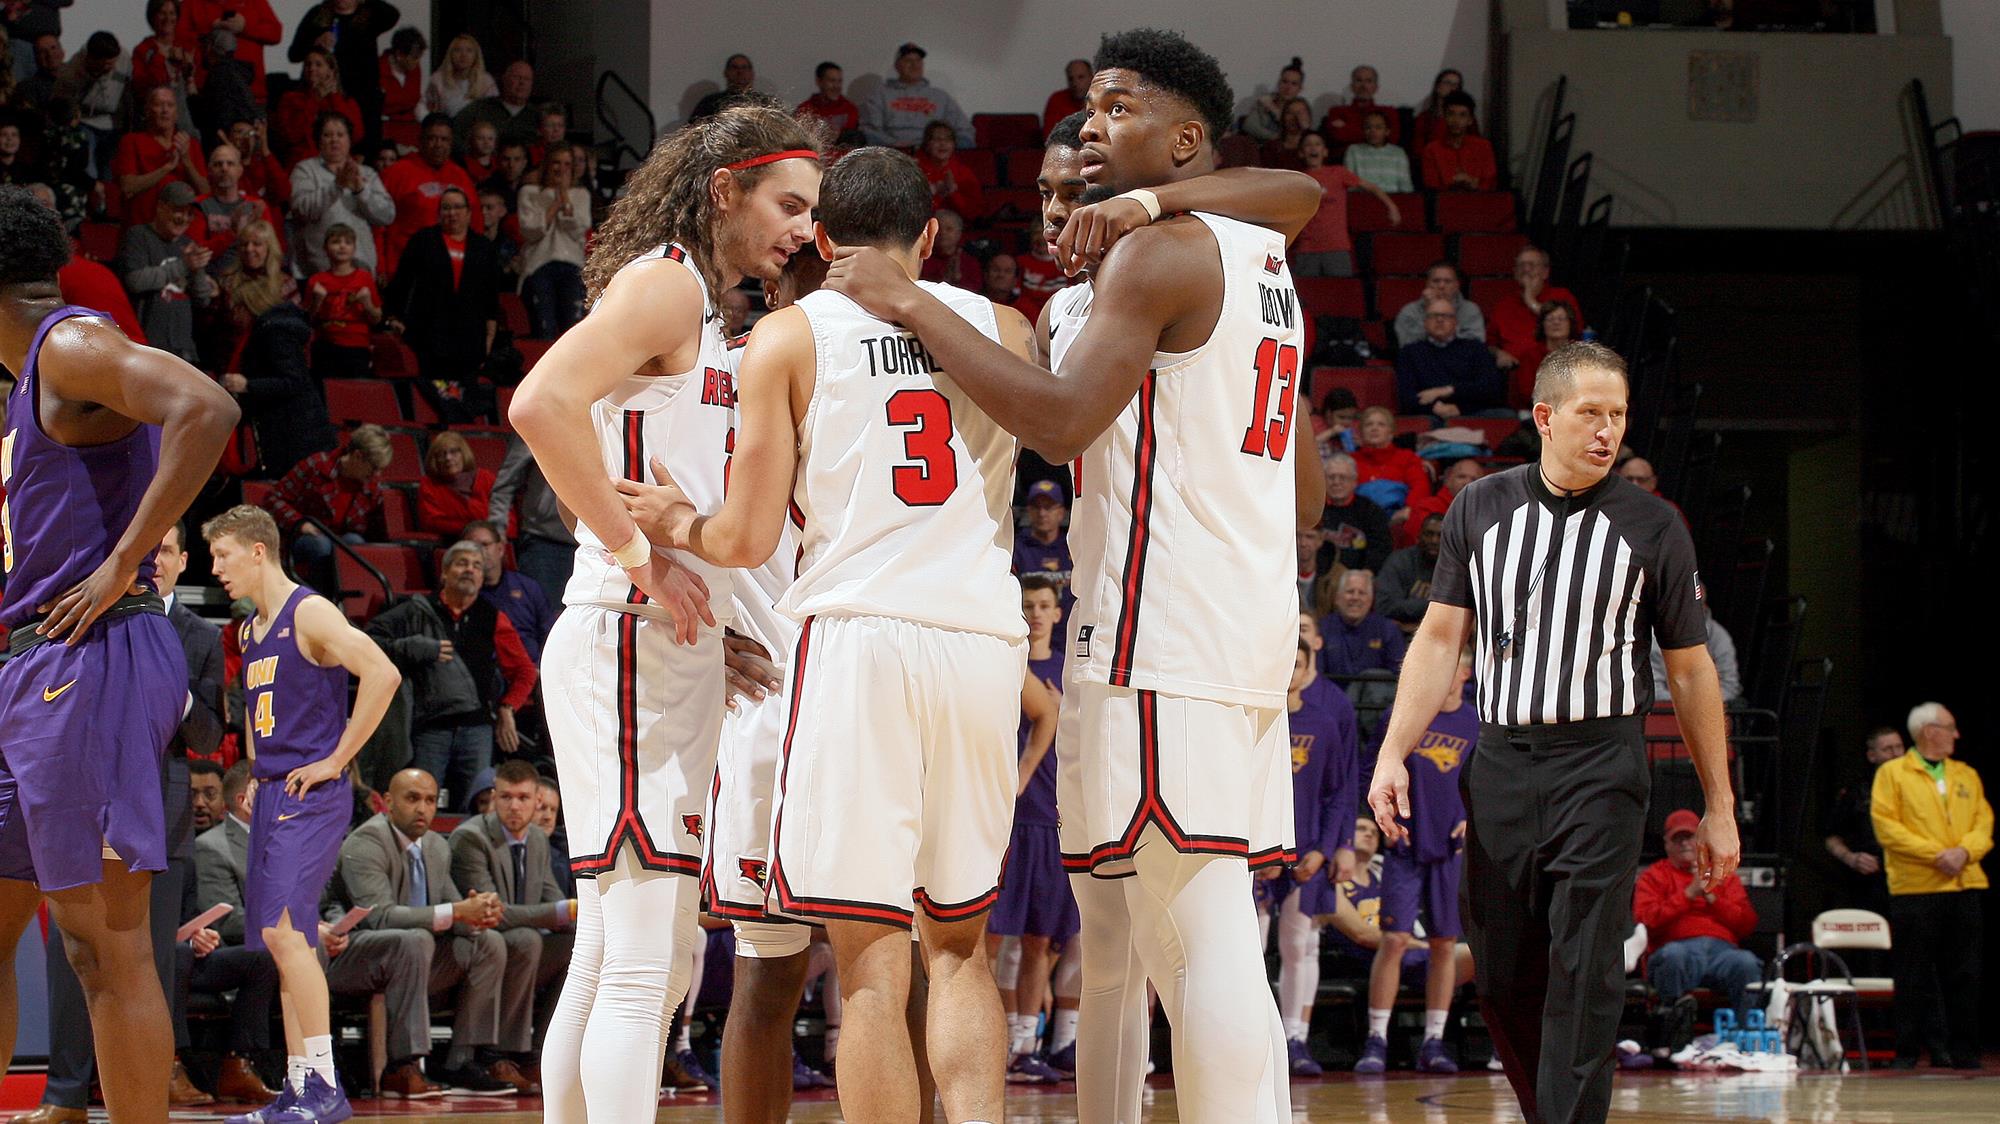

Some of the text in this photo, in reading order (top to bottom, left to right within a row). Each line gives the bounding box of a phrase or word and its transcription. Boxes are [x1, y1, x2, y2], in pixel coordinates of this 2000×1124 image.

[1240, 336, 1299, 462] 13
[885, 388, 959, 507] 3
[246, 655, 280, 691] UNI
[254, 691, 276, 738] 4
[1418, 730, 1469, 754] UNI
